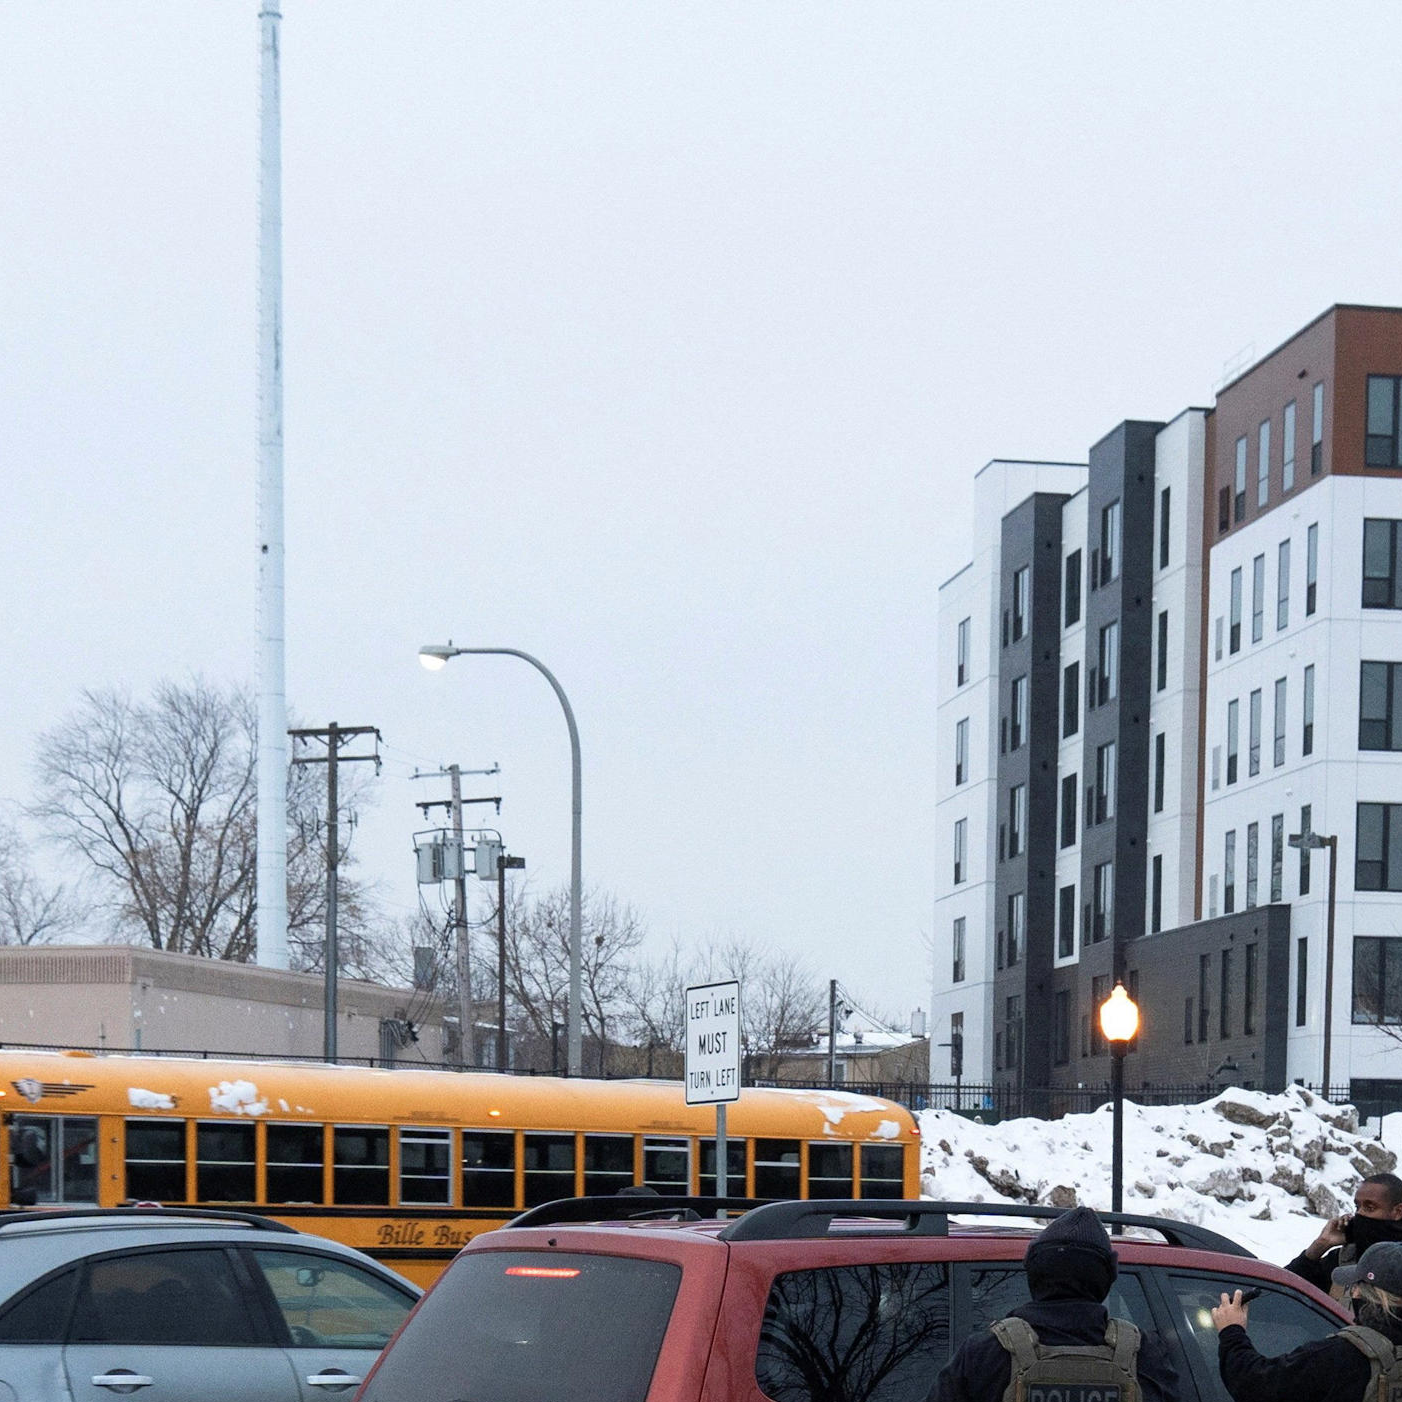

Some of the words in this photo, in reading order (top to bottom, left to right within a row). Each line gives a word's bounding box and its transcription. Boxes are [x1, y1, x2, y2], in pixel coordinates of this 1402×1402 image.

[690, 1001, 709, 1020] LEFT
[714, 997, 736, 1017] LANE
[698, 1032, 728, 1056] MUST
[689, 1071, 711, 1089] TURN
[716, 1068, 736, 1087] LEFT
[377, 1222, 425, 1245] Bille
[434, 1225, 473, 1246] Bus
